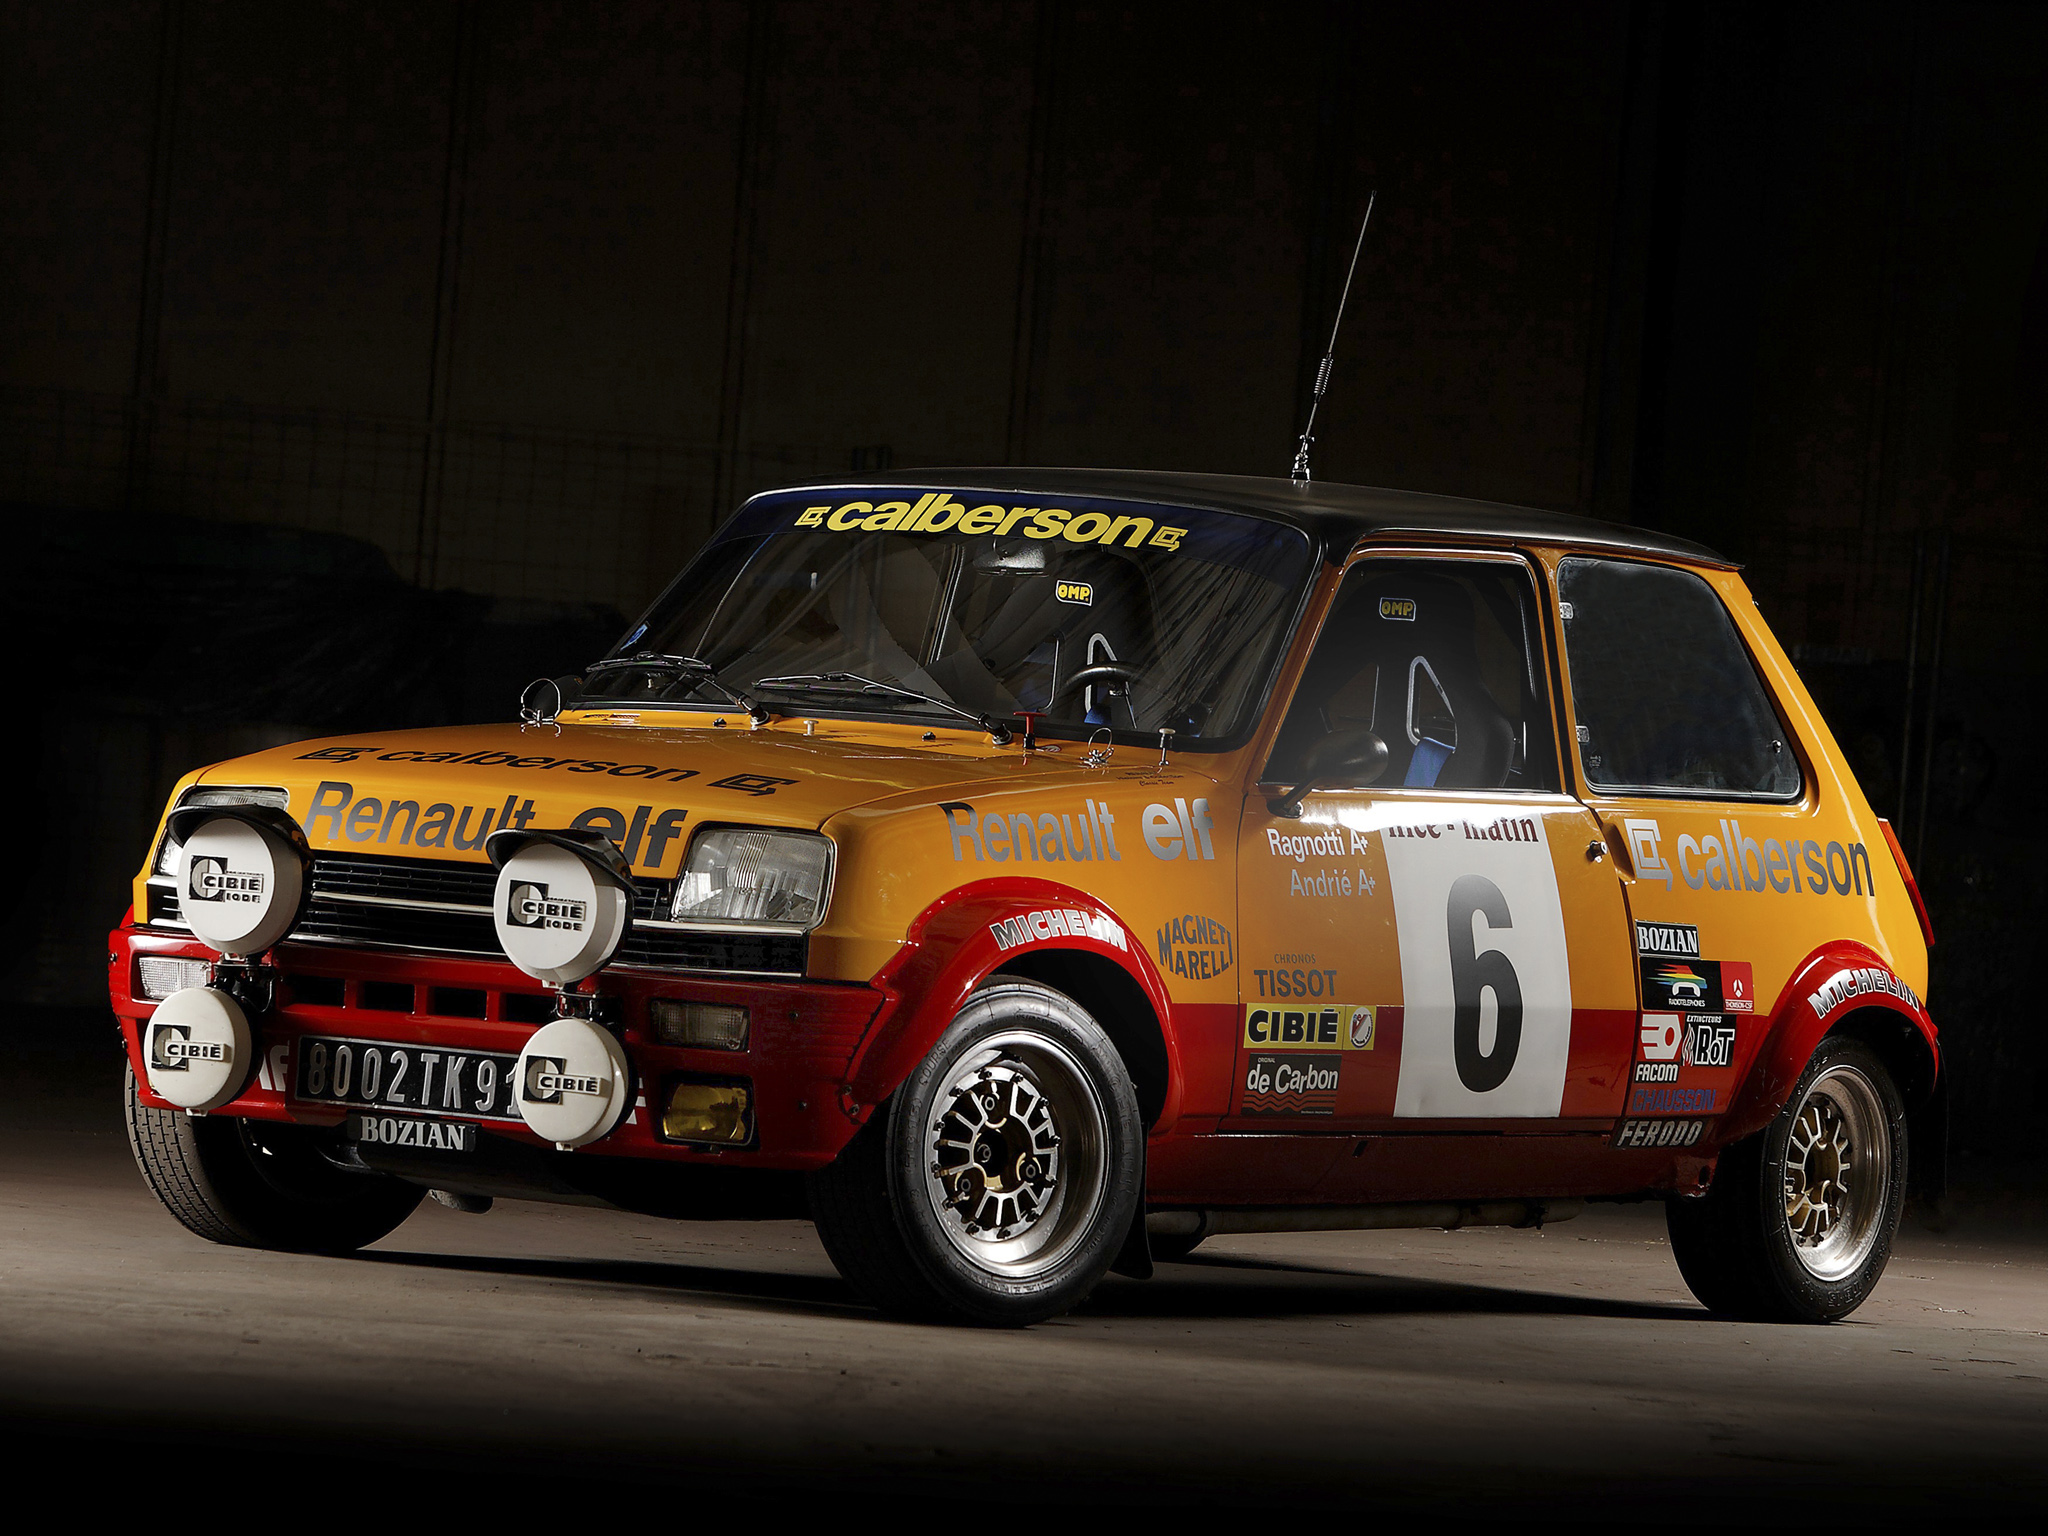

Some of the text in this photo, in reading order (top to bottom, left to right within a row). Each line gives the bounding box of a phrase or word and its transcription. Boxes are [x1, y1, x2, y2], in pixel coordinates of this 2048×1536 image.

[827, 494, 1154, 548] calberson
[376, 750, 701, 782] calberson
[302, 781, 536, 851] Renault
[938, 797, 1215, 862] Renault elf
[1266, 828, 1346, 863] Ragnotti
[1677, 818, 1876, 897] calberson
[1290, 868, 1352, 897] Andrié
[990, 909, 1128, 953] MICHELIN
[1636, 926, 1698, 954] BOZIAN
[1274, 953, 1316, 964] CHRONOS
[1253, 969, 1337, 998] TISSOT
[1446, 874, 1523, 1093] 6
[1807, 967, 1920, 1020] MICHELIN
[1247, 1064, 1339, 1094] de Carbon
[1635, 1063, 1679, 1082] FACOM
[1632, 1089, 1717, 1112] CHAUSSON
[360, 1116, 466, 1151] BOZIAN
[1616, 1120, 1703, 1147] FERODO
